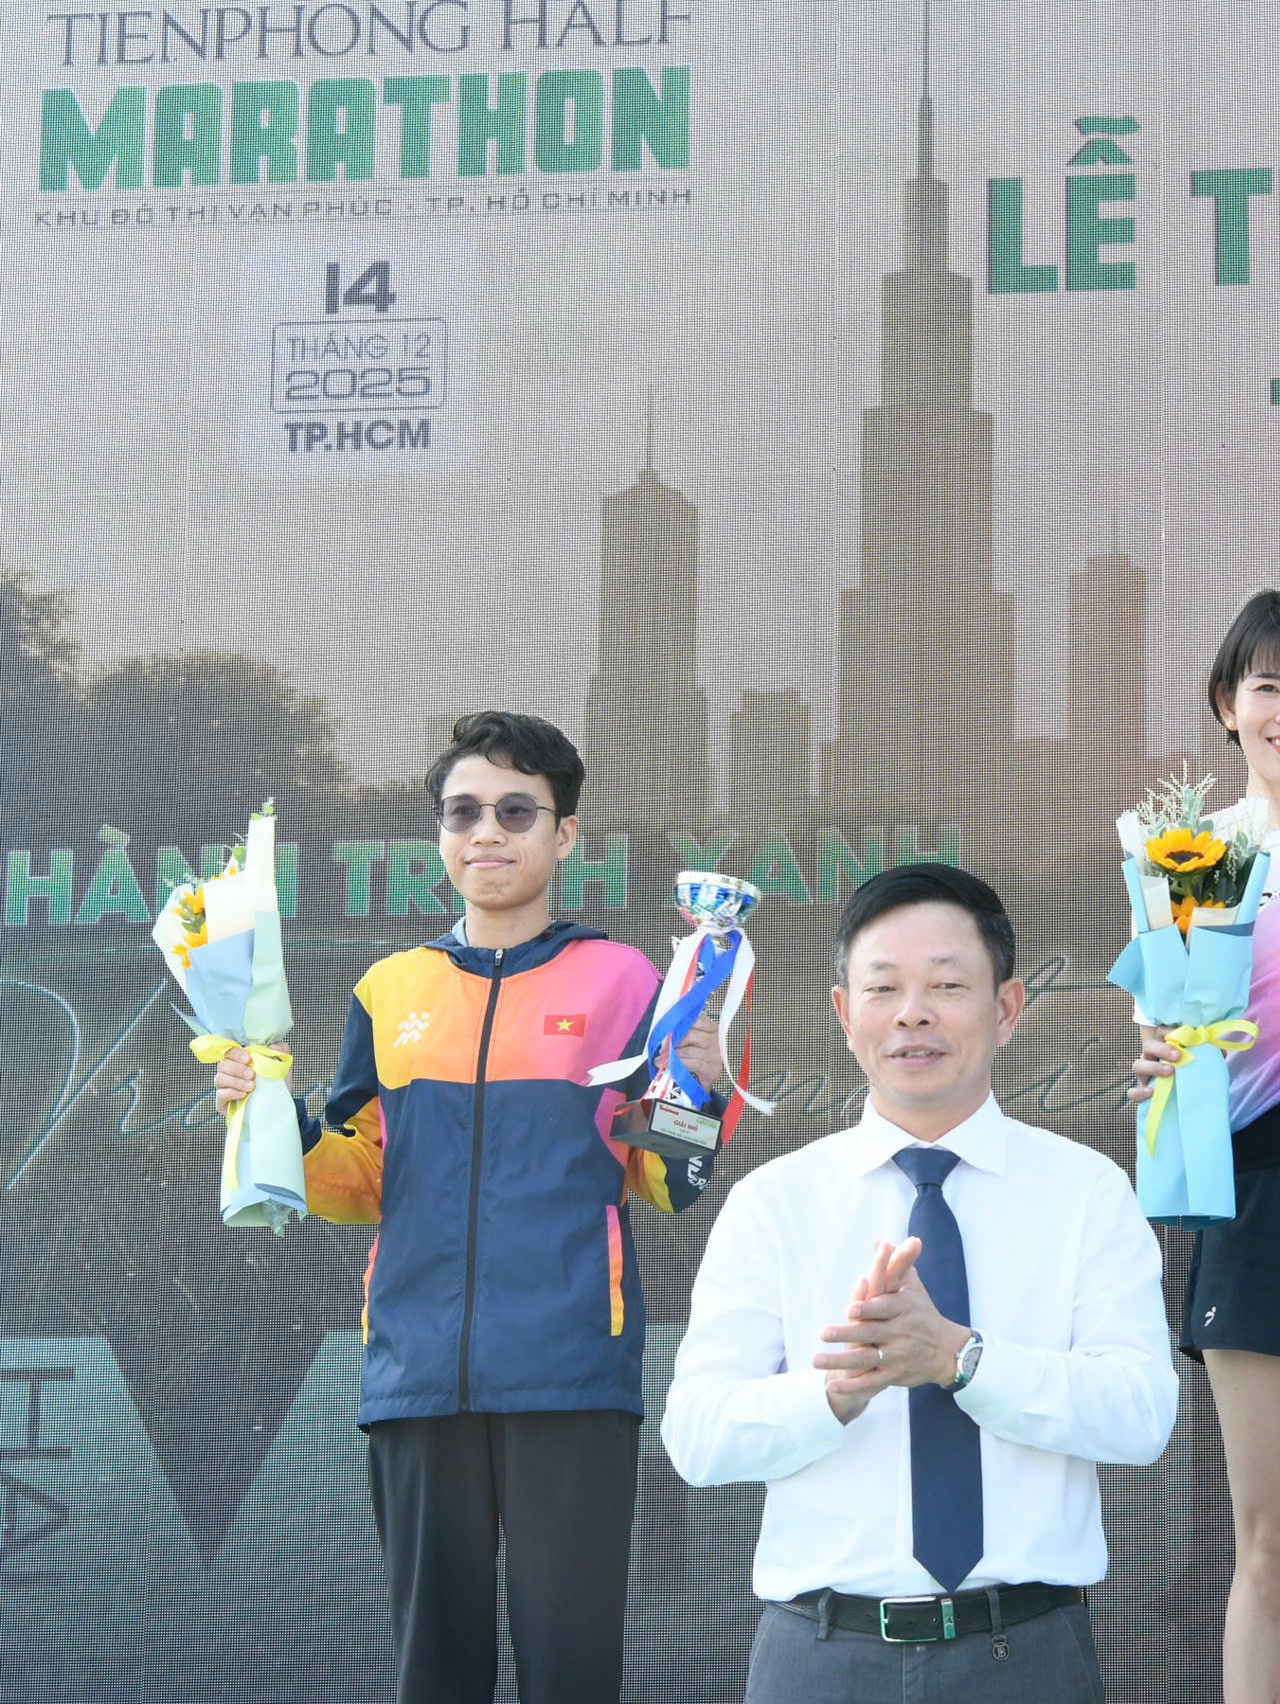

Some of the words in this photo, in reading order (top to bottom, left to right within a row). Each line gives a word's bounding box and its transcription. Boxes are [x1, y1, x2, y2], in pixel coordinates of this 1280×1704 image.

[501, 0, 691, 51] HALF
[39, 65, 692, 193] MARATHON
[609, 188, 691, 206] MINH
[986, 115, 1138, 294] LỄ
[325, 260, 397, 315] 14
[287, 331, 389, 361] THÁNG
[403, 333, 431, 359] 12
[285, 366, 432, 401] 2025
[285, 418, 432, 453] TP.HCM
